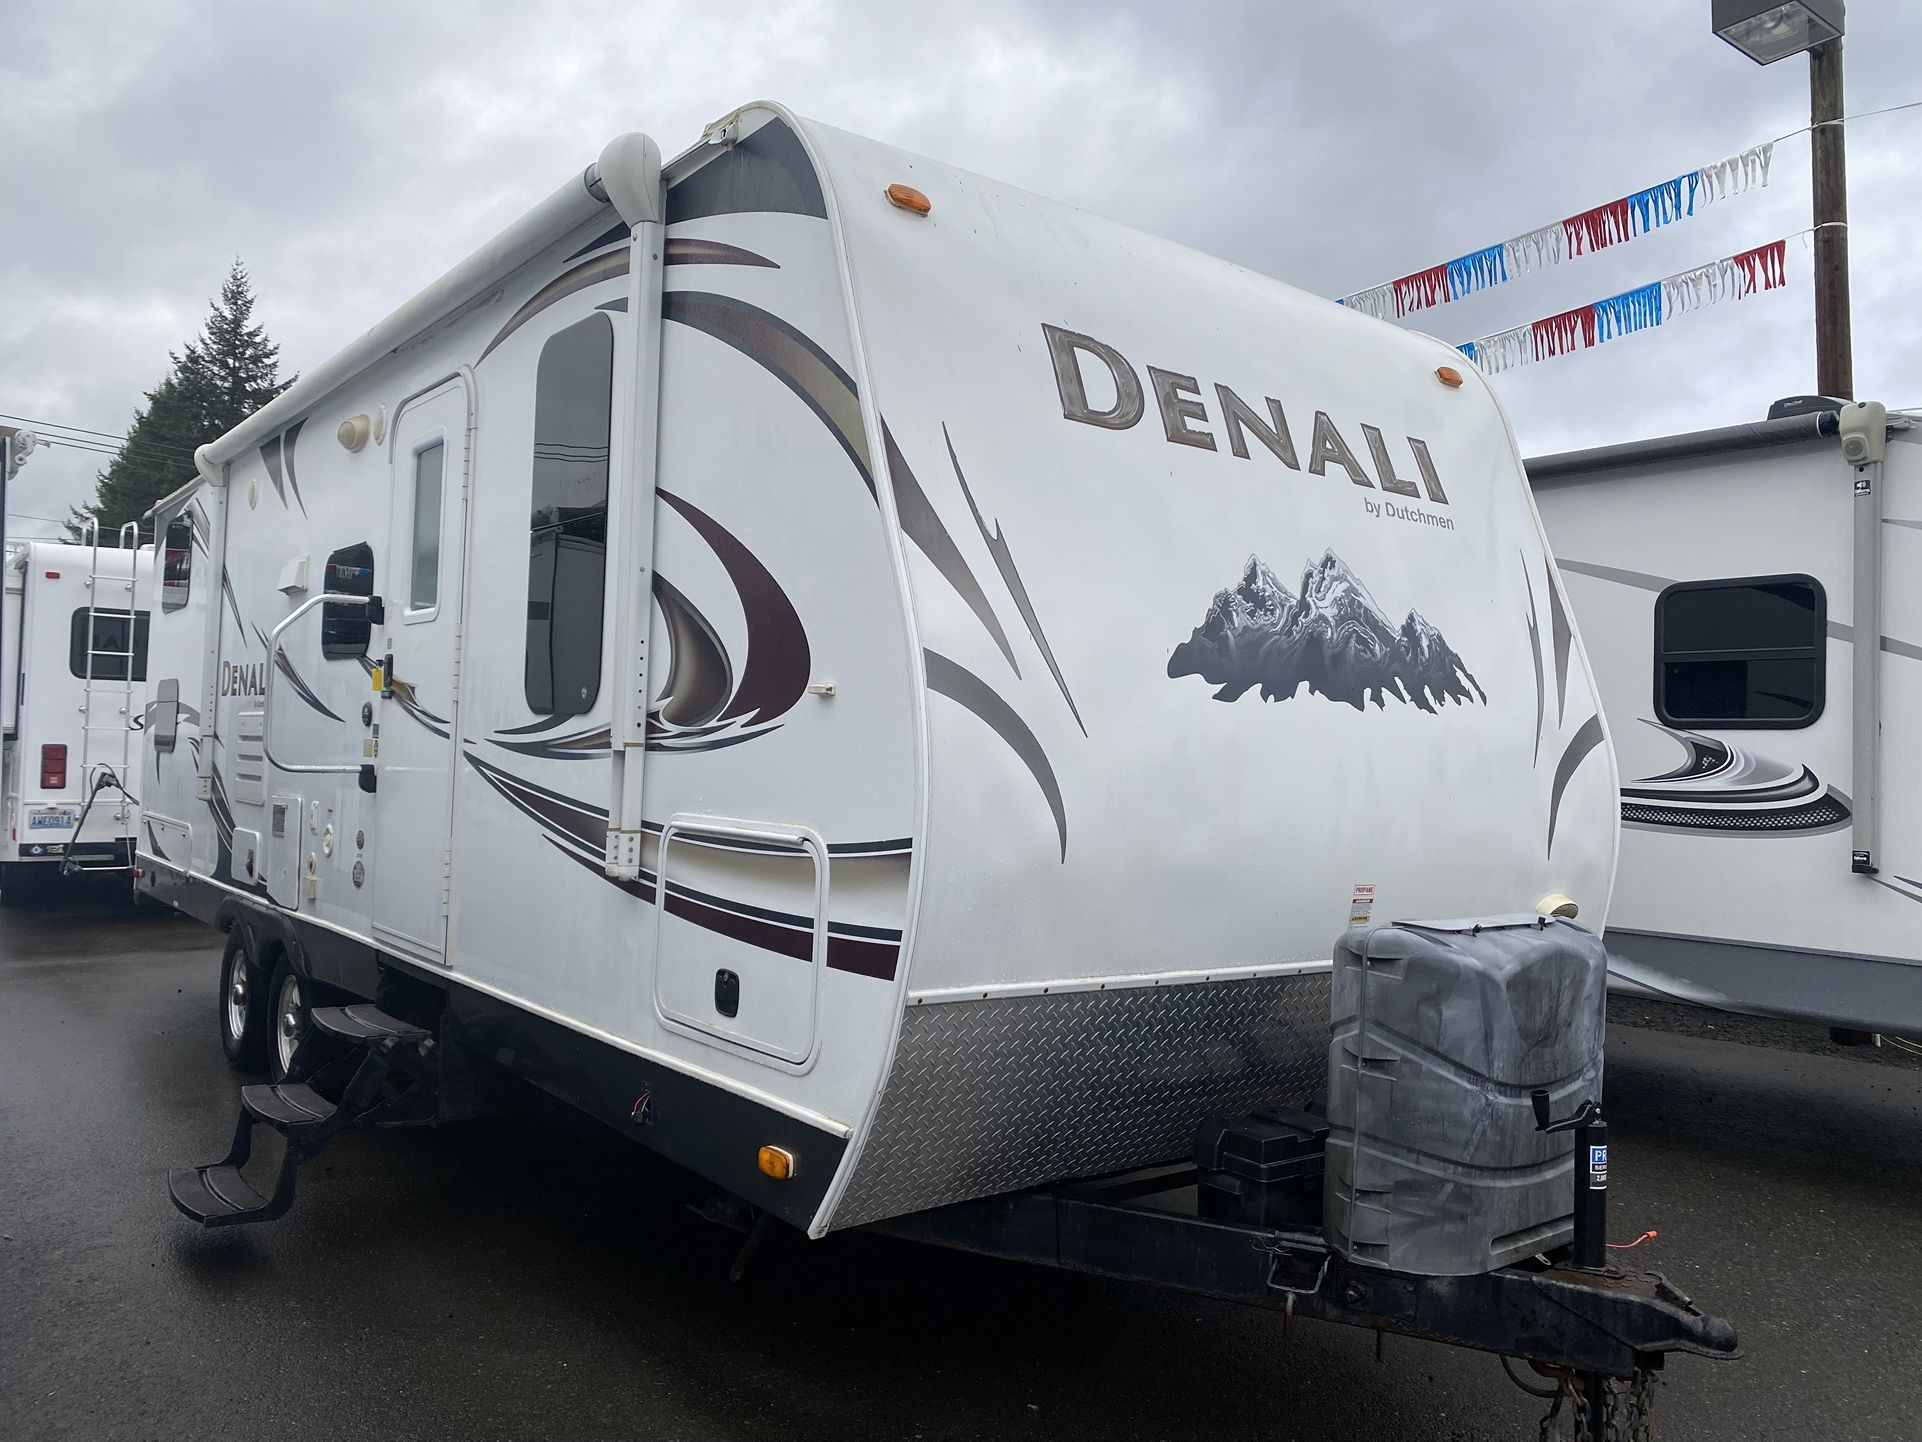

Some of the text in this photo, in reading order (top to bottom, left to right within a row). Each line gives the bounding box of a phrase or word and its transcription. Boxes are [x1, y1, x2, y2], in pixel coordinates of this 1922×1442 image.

[1041, 322, 1449, 505] DENALI
[1364, 497, 1455, 531] by Dutchmen
[221, 660, 266, 696] DENAL
[1595, 1150, 1607, 1161] PR
